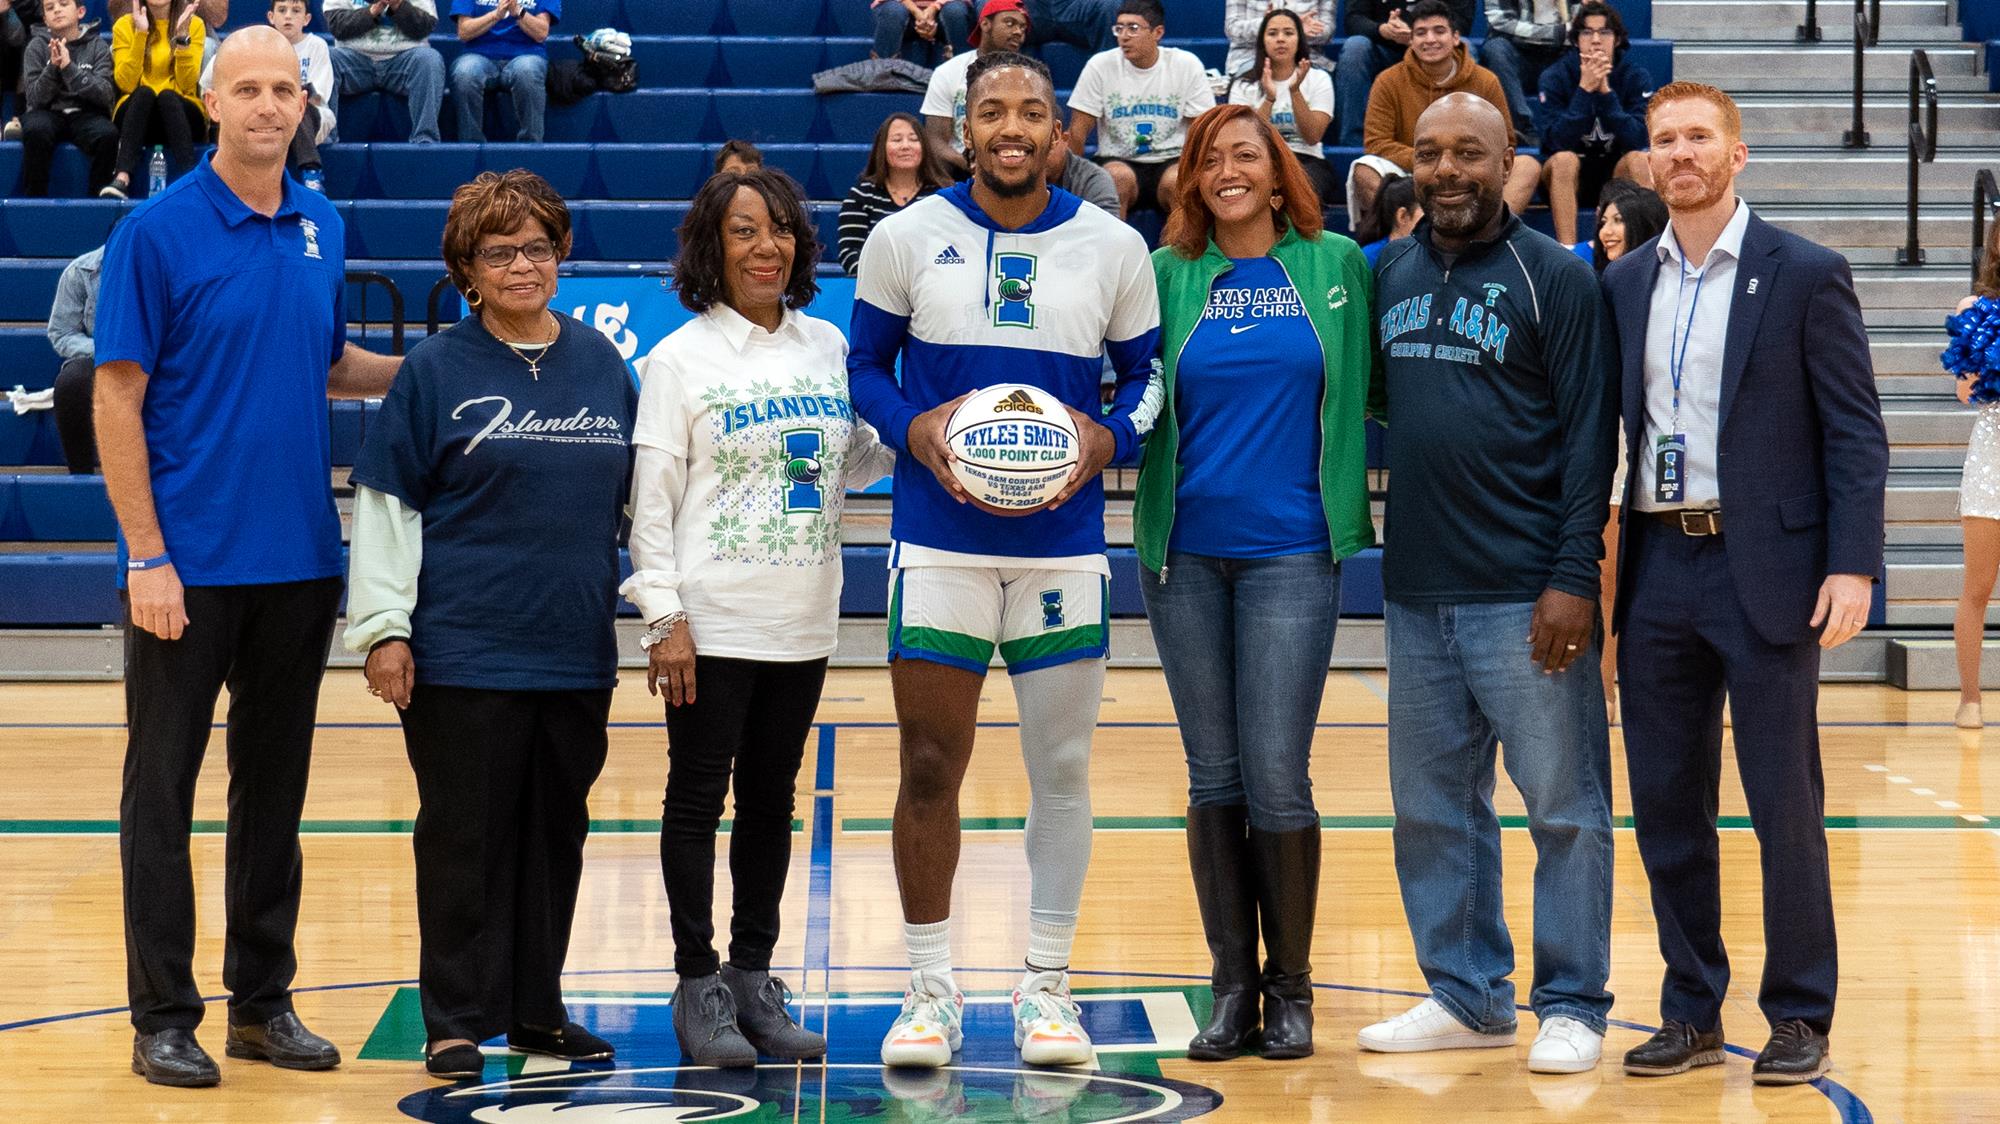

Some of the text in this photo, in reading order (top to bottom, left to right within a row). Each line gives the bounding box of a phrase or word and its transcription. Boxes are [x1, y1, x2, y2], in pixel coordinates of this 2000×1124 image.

[1112, 104, 1178, 119] ISLANDERS
[934, 257, 965, 265] adidas
[1208, 287, 1297, 306] EXAS A&M
[1205, 304, 1306, 319] RPUS CHRIST
[1381, 293, 1432, 350] TEXAS
[1449, 297, 1509, 364] A&M
[1391, 343, 1481, 365] CORPUS CHRISTI
[993, 401, 1044, 415] adidas
[452, 396, 620, 456] Islanders
[964, 424, 1069, 449] MYLES SMITH
[966, 448, 1067, 462] 1,000 POINT CLUB
[964, 465, 987, 479] TEXAS
[988, 475, 1008, 484] A&M
[1008, 477, 1040, 485] CORPUS
[987, 481, 1045, 492] VS TEXAS A&M
[984, 494, 1044, 506] 2017-2022
